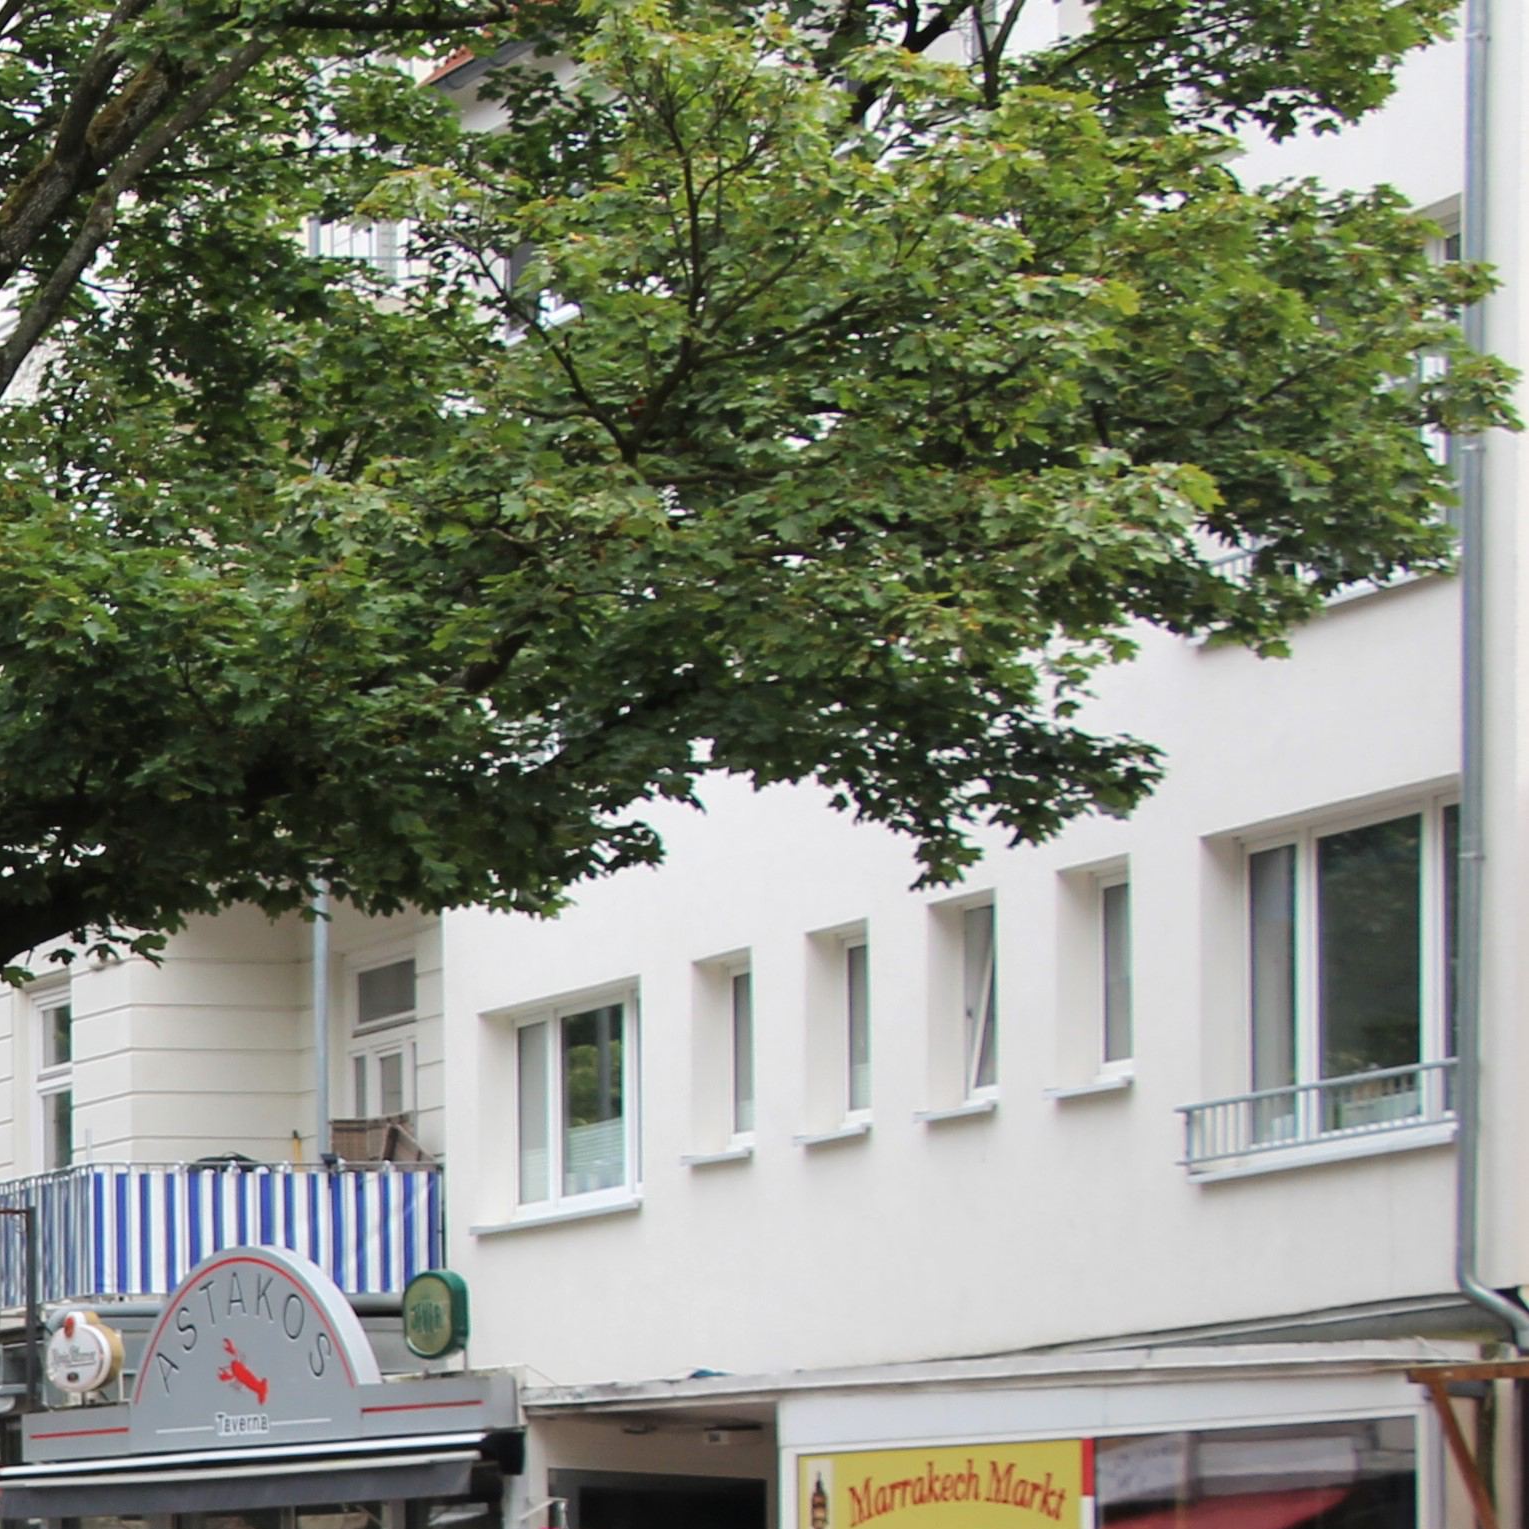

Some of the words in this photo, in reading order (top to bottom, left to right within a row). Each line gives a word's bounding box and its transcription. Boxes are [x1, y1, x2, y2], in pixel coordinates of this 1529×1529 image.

[155, 1271, 332, 1393] ASTAKOS
[214, 1411, 269, 1436] Taverna
[848, 1458, 979, 1527] Marrakech
[985, 1461, 1066, 1520] Markt
